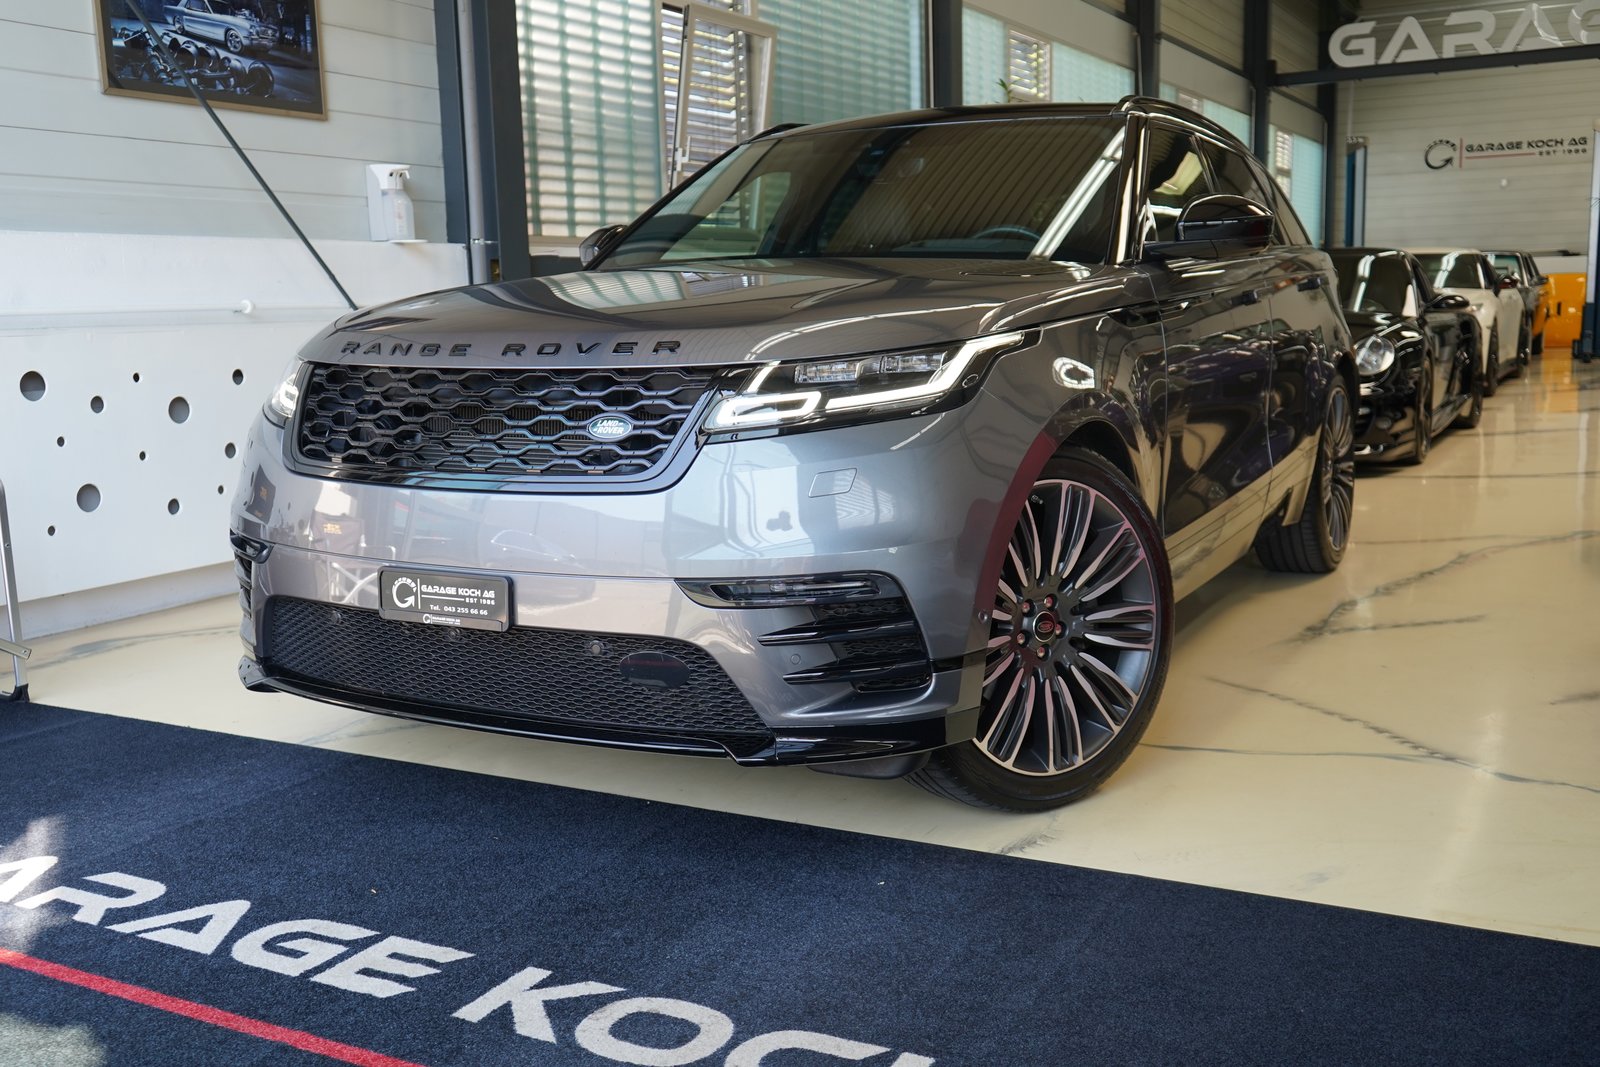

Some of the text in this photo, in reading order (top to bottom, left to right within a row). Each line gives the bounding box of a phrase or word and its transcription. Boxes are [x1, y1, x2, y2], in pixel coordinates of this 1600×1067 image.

[1465, 136, 1588, 153] GARAGE KOCH AG
[340, 340, 682, 358] RANGE ROVER
[421, 584, 496, 599] GARAGE KOCH AG
[443, 605, 456, 613] 043
